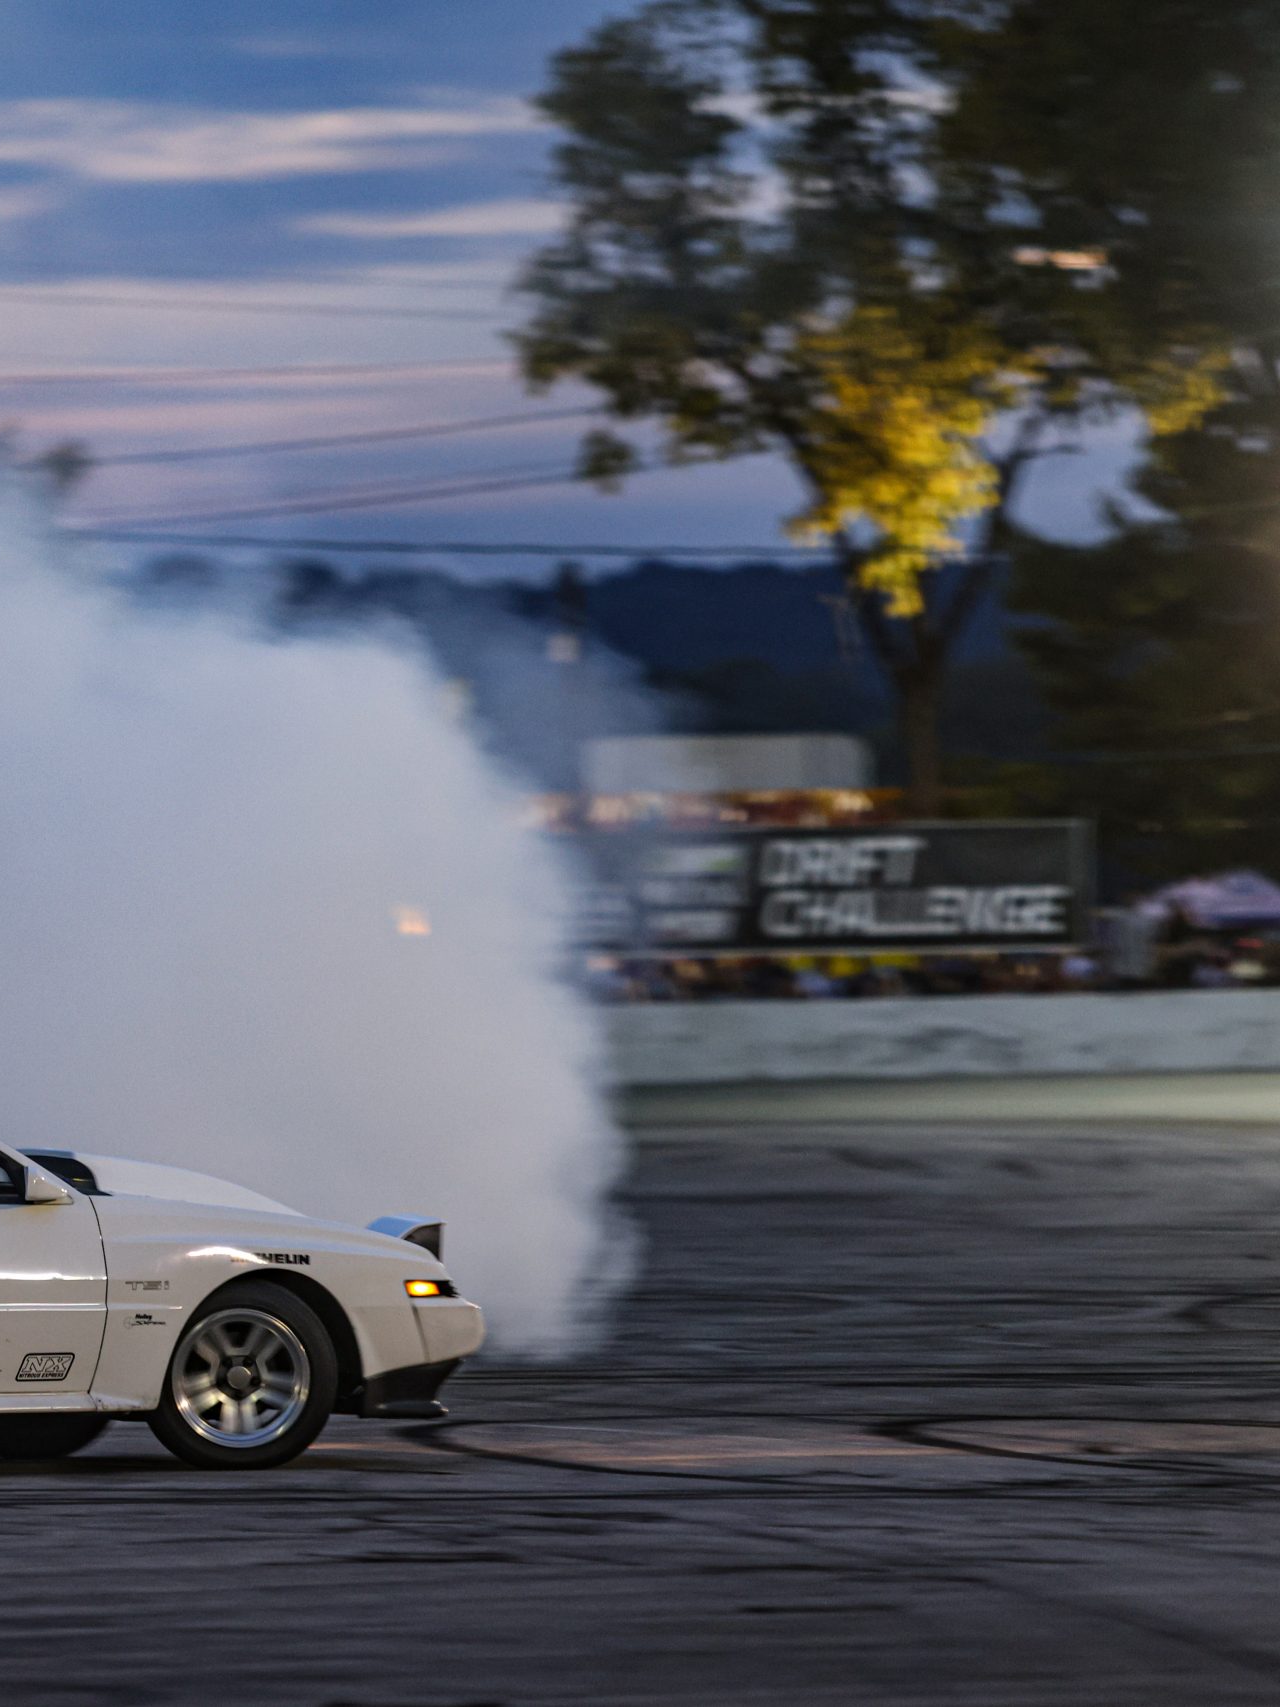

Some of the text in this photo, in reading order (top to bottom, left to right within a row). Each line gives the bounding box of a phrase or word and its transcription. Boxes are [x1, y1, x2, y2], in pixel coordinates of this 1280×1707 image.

[760, 836, 927, 886] DRIFT
[761, 885, 1072, 937] CHALLENGE
[21, 1356, 72, 1373] NX
